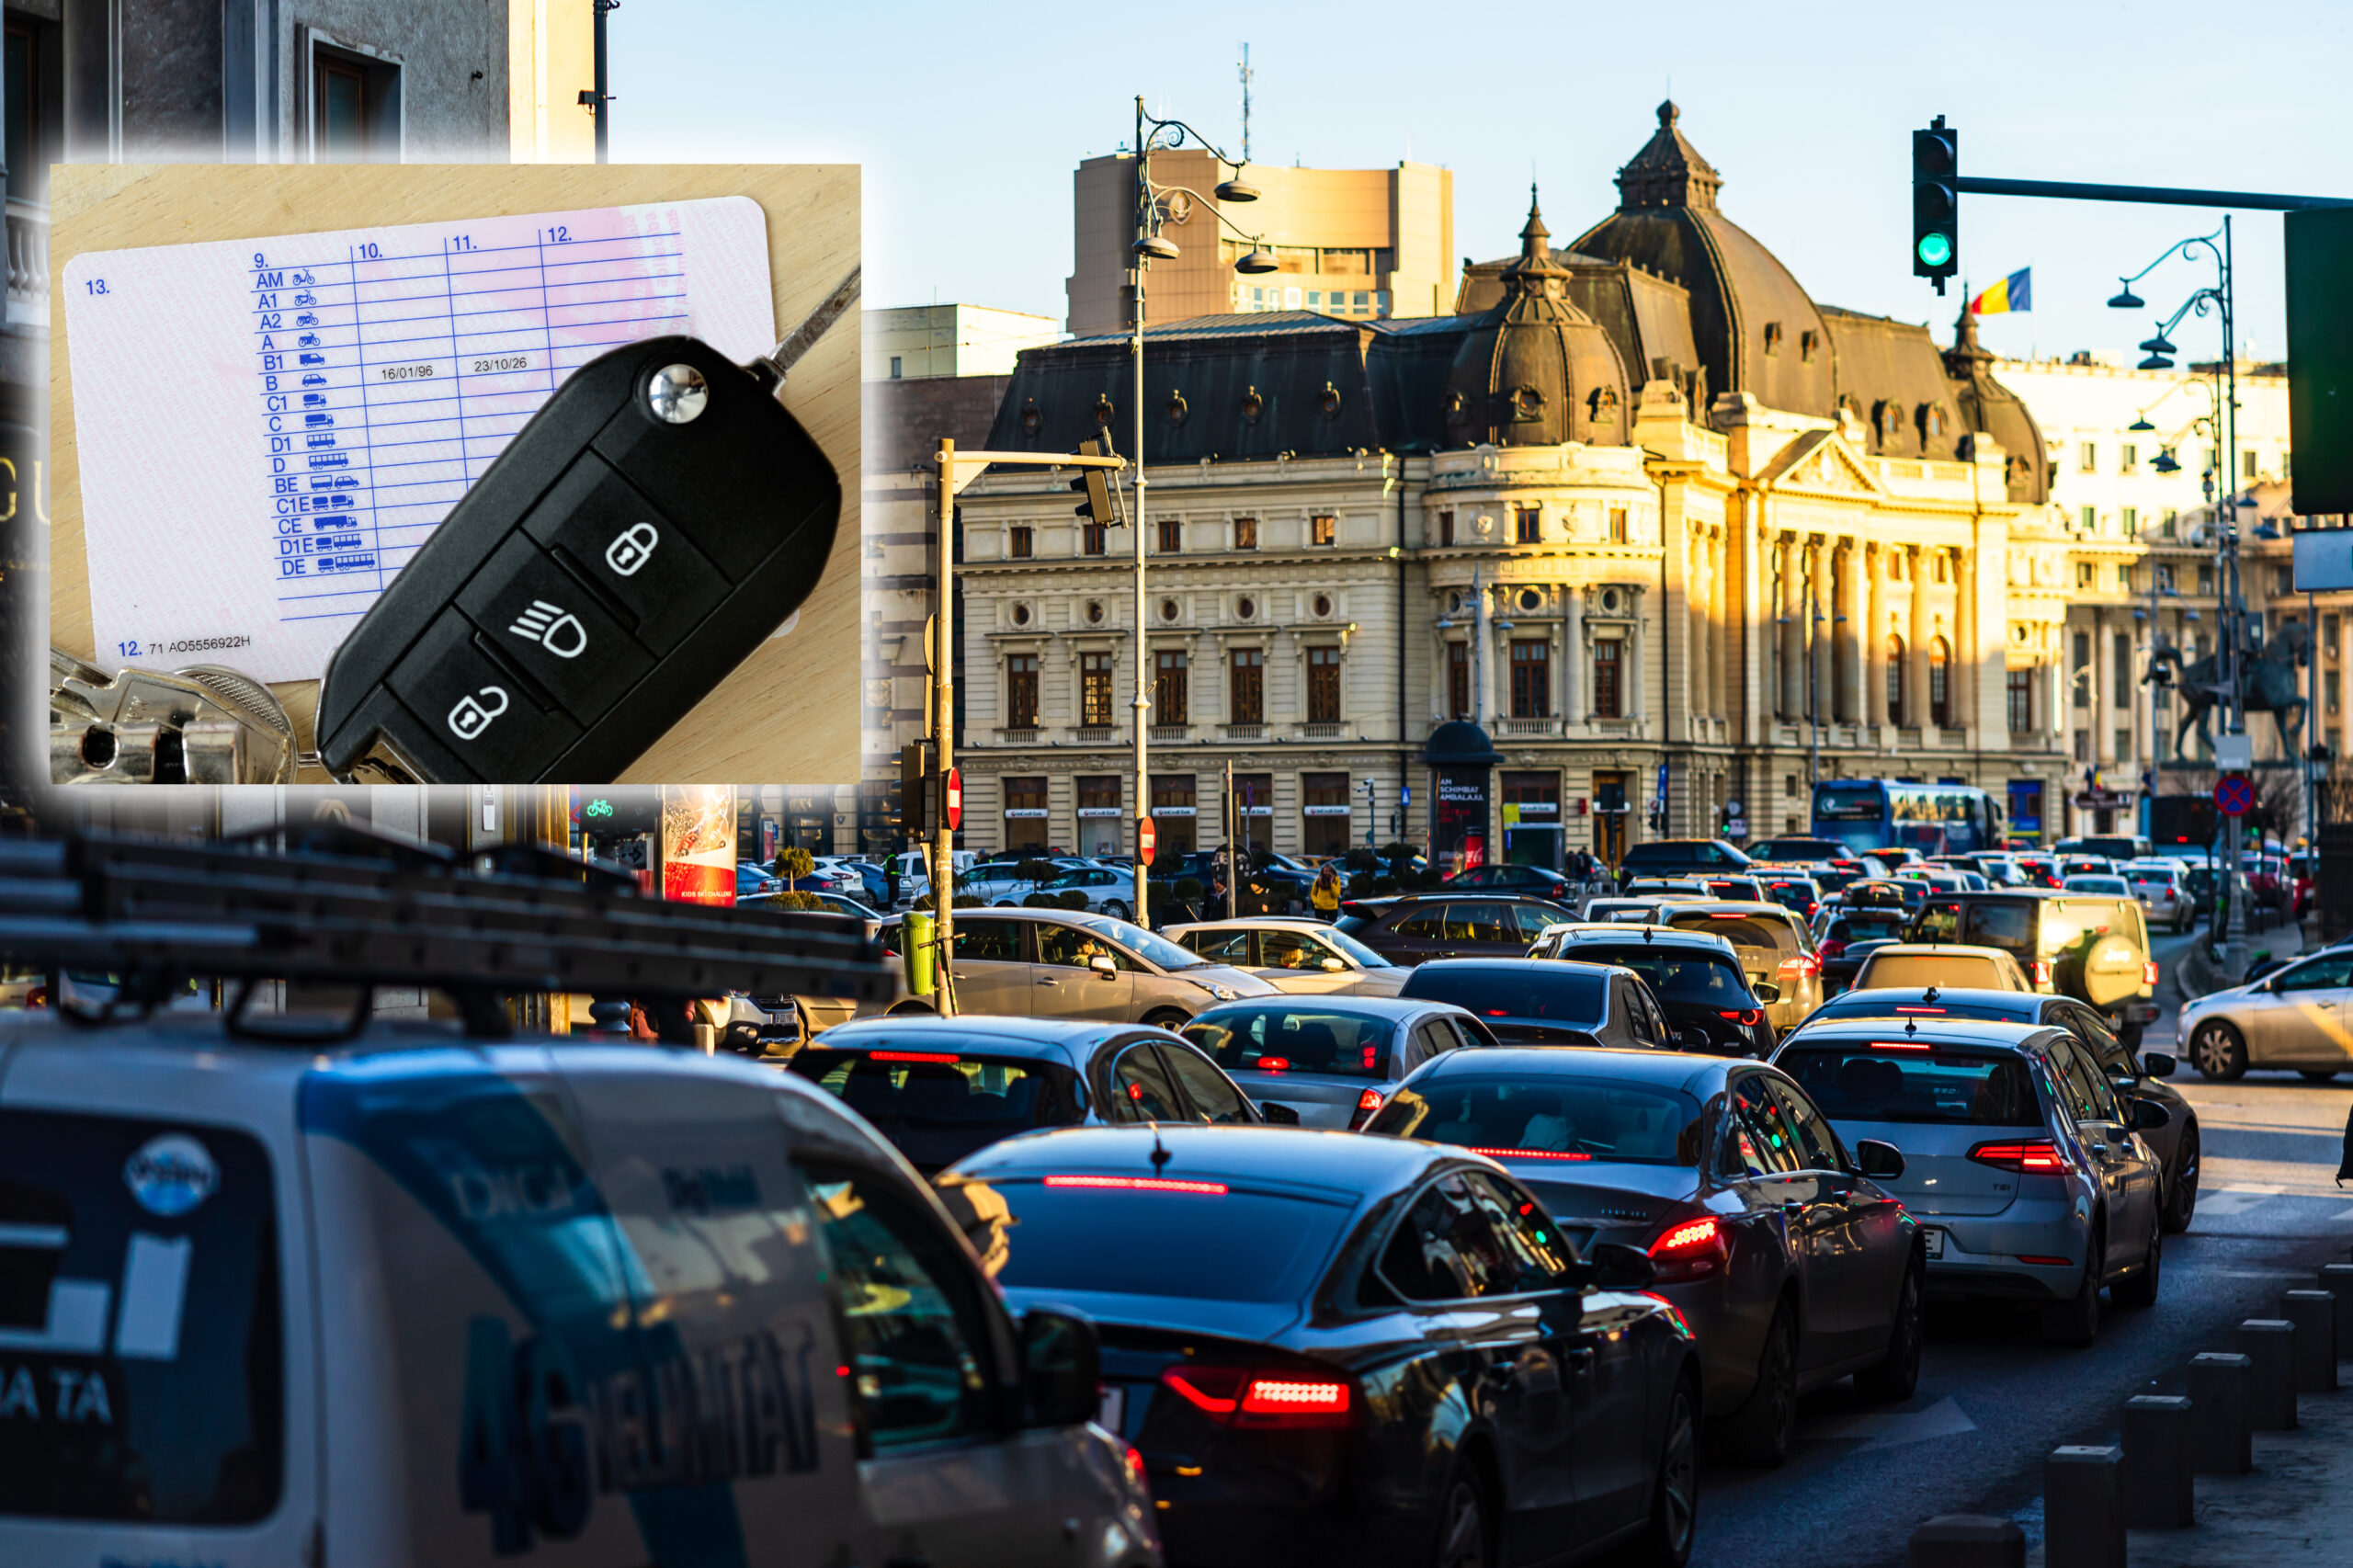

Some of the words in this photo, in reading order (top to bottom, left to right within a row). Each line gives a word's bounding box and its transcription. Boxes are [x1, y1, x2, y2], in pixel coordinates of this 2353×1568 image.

[254, 253, 269, 268] 9.
[358, 243, 383, 260] 10.
[453, 234, 478, 252] 11.
[548, 226, 572, 243] 12.
[85, 278, 110, 296] 13.
[256, 271, 284, 289] AM
[258, 292, 278, 309] A1
[260, 313, 282, 330] A2
[262, 335, 275, 350] A
[264, 354, 283, 370] B1
[265, 375, 278, 392] B
[381, 365, 434, 381] 16/01/96
[474, 357, 528, 372] 23/10/26
[267, 396, 288, 412] C1
[269, 416, 282, 433] C
[271, 436, 291, 453] D1
[273, 457, 286, 473] D
[275, 477, 299, 494] BE
[276, 496, 311, 515] C1E
[278, 517, 302, 535] CE
[280, 537, 314, 555] D1E
[282, 559, 306, 576] DE
[118, 640, 142, 657] 12.
[149, 643, 164, 655] 71
[49, 1365, 114, 1426] TA
